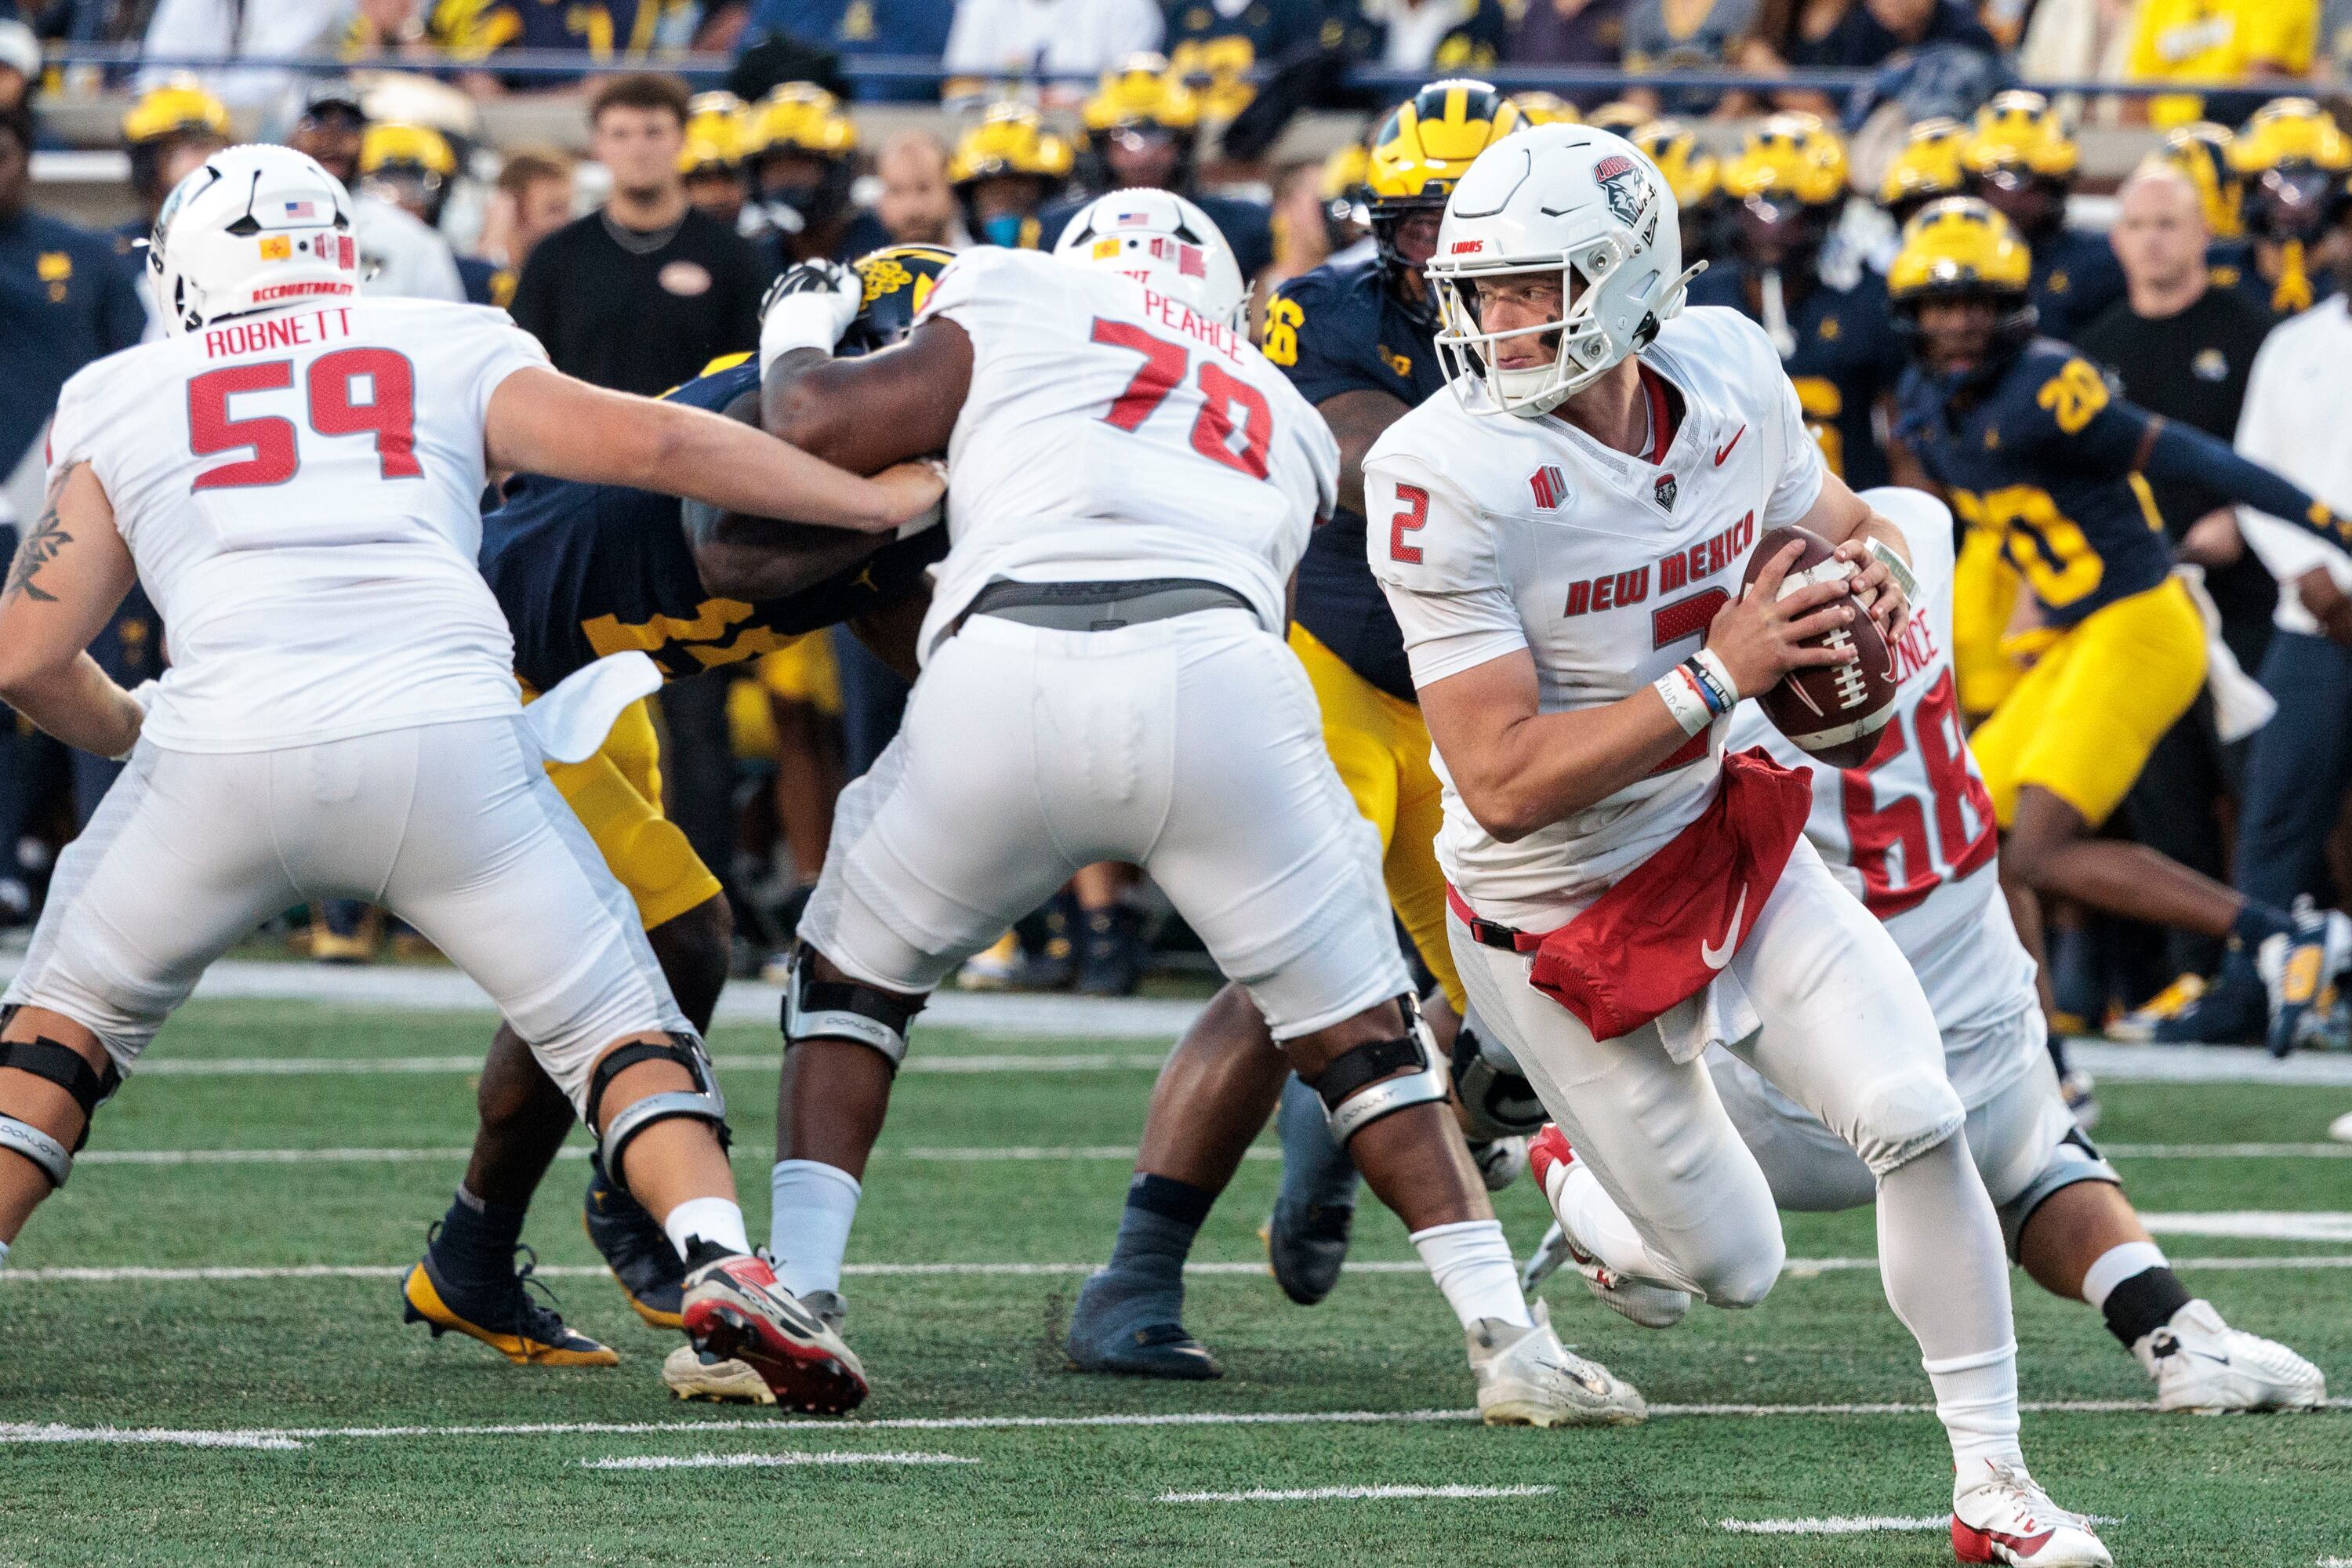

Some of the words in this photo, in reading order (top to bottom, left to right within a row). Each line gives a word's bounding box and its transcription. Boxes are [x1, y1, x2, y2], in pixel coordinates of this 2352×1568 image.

[1451, 240, 1483, 255] LOBOS
[205, 307, 351, 358] ROBNETT
[1145, 288, 1245, 367] PEARCE
[186, 346, 425, 495] 59
[2037, 357, 2110, 434] 20
[1390, 482, 1430, 565] 2
[1563, 564, 1650, 618] NEW
[1658, 509, 1755, 597] MEXICO
[1897, 608, 1939, 686] NCE
[1840, 664, 1998, 923] 68
